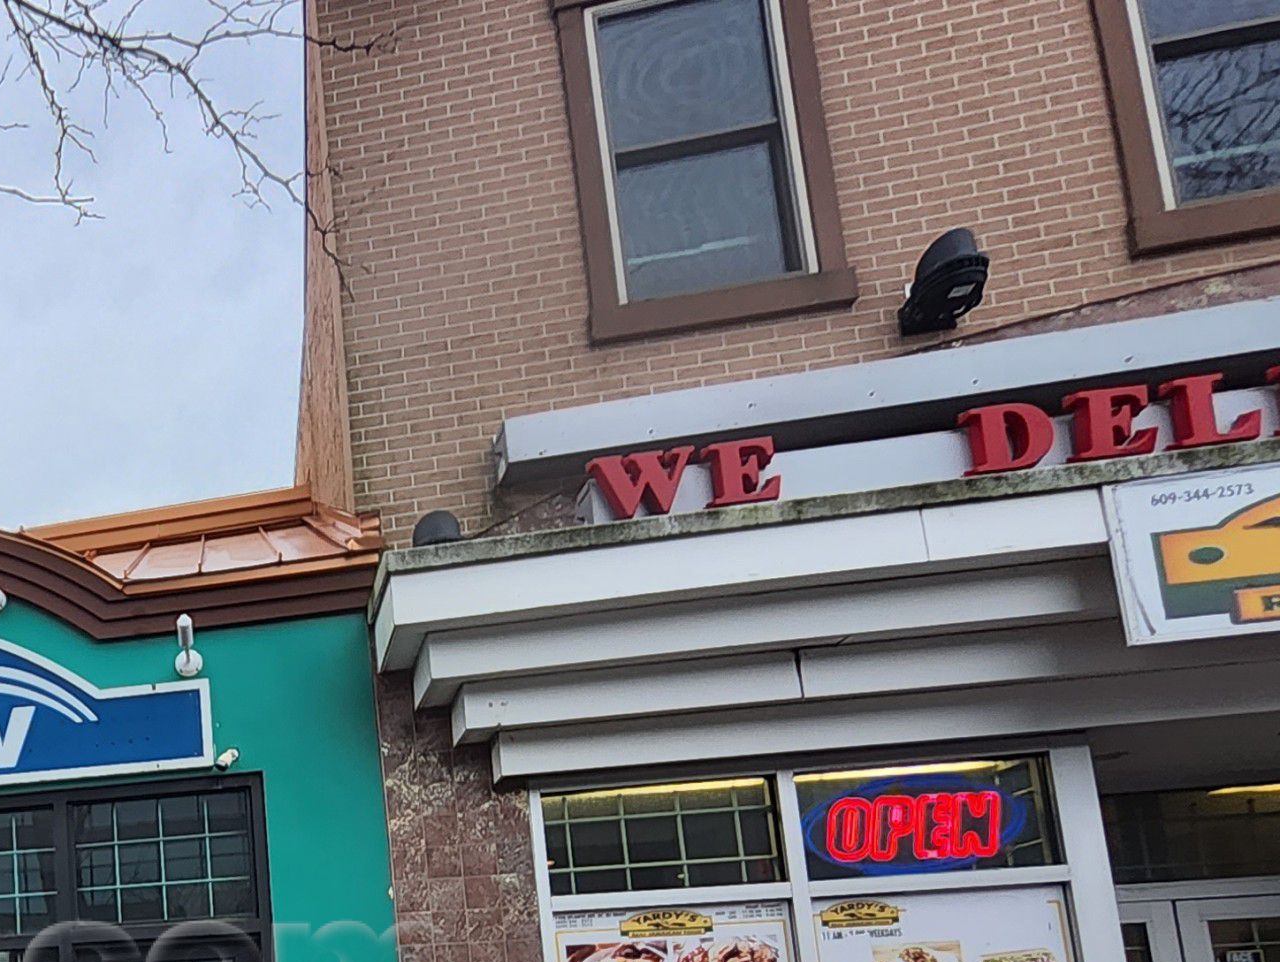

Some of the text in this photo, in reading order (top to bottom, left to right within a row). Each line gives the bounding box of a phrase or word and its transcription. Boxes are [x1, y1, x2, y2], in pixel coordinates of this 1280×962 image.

[586, 365, 1280, 520] WE DEL
[1151, 483, 1254, 506] 609-344-2573
[826, 790, 1001, 862] OPEN
[631, 911, 698, 925] YARDY'S
[829, 902, 886, 915] YARDY'S
